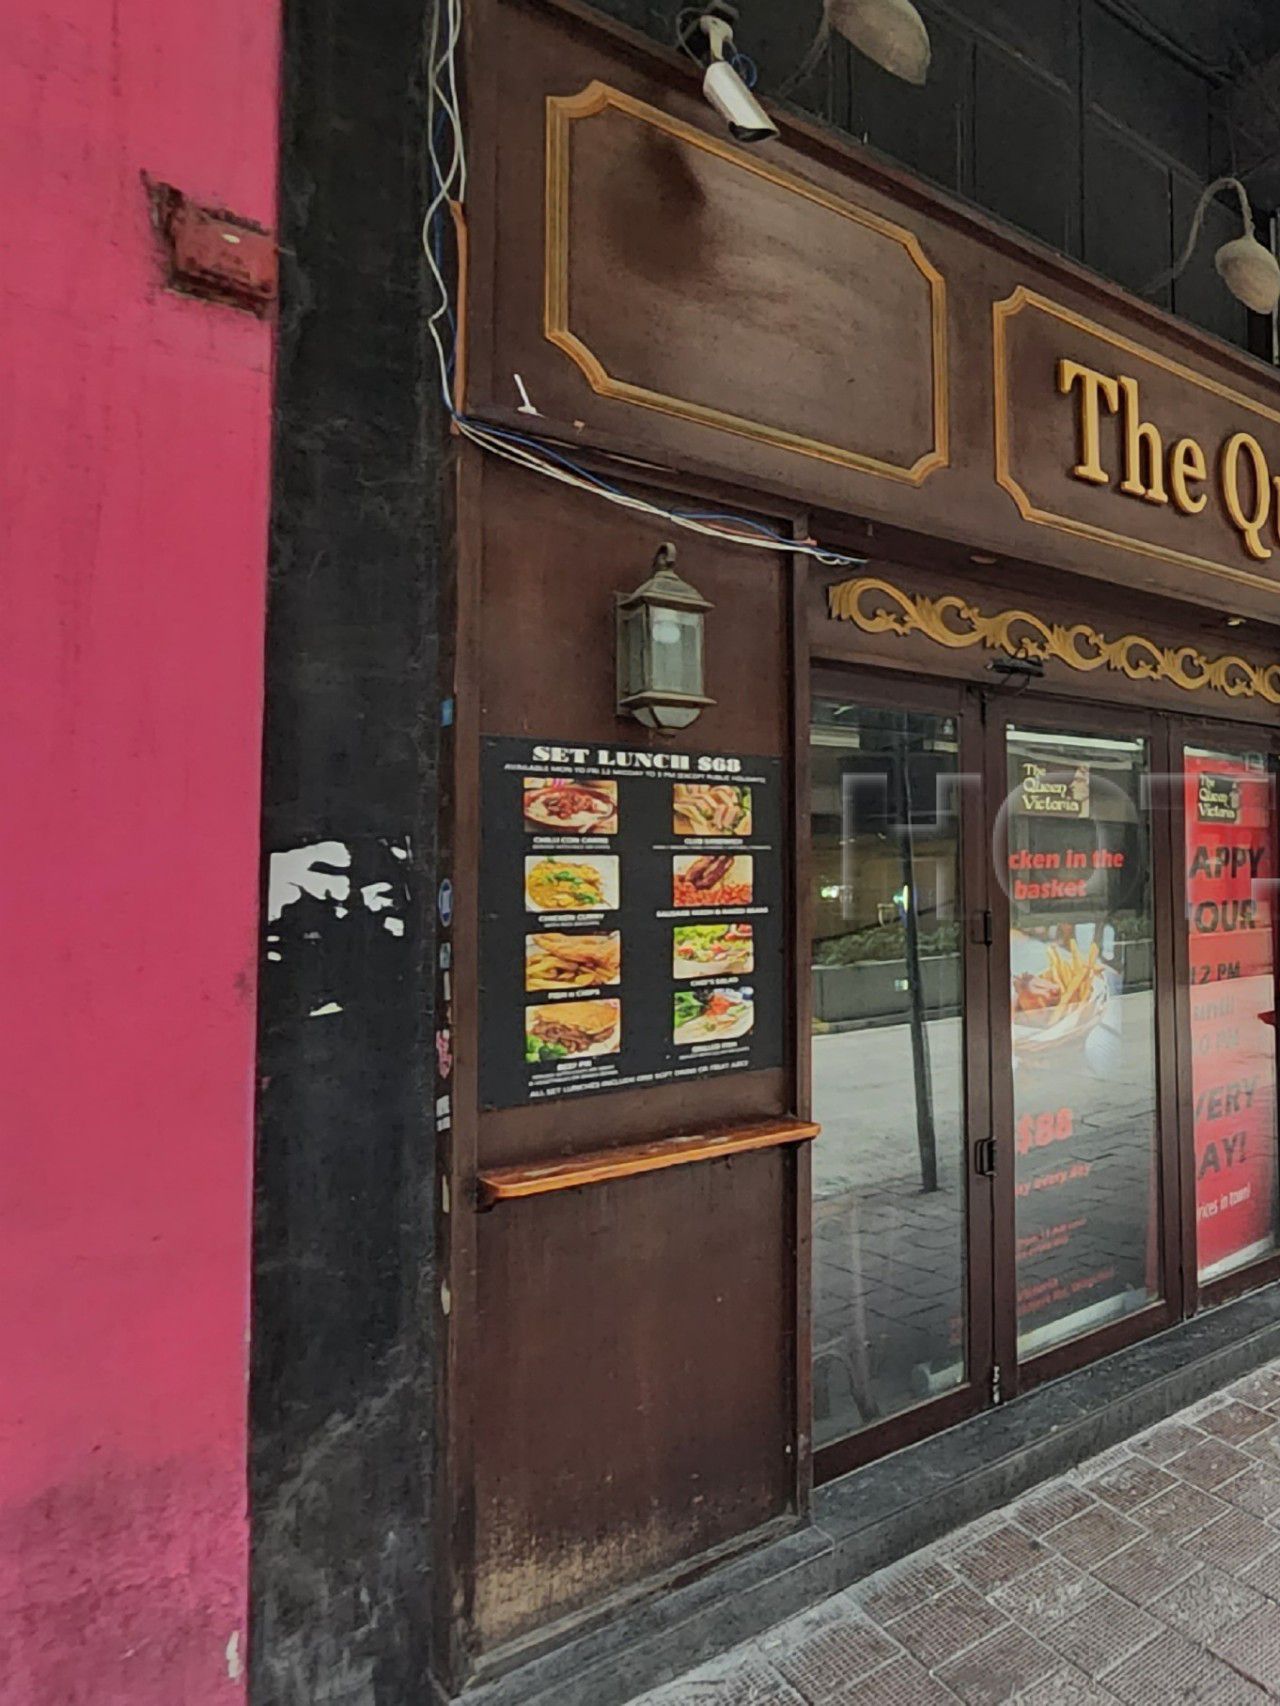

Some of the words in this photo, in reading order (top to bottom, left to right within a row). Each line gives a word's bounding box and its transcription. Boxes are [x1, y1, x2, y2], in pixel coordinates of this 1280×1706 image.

[1059, 358, 1208, 514] The
[532, 745, 590, 764] SET
[597, 749, 690, 771] LUNCH
[697, 756, 742, 773] $68
[1022, 763, 1047, 777] The
[1022, 777, 1068, 798] Queen
[1022, 794, 1080, 811] Victoria
[1065, 849, 1087, 869] in
[1091, 848, 1124, 869] the
[1014, 878, 1087, 900] basket
[1195, 899, 1257, 933] OUR
